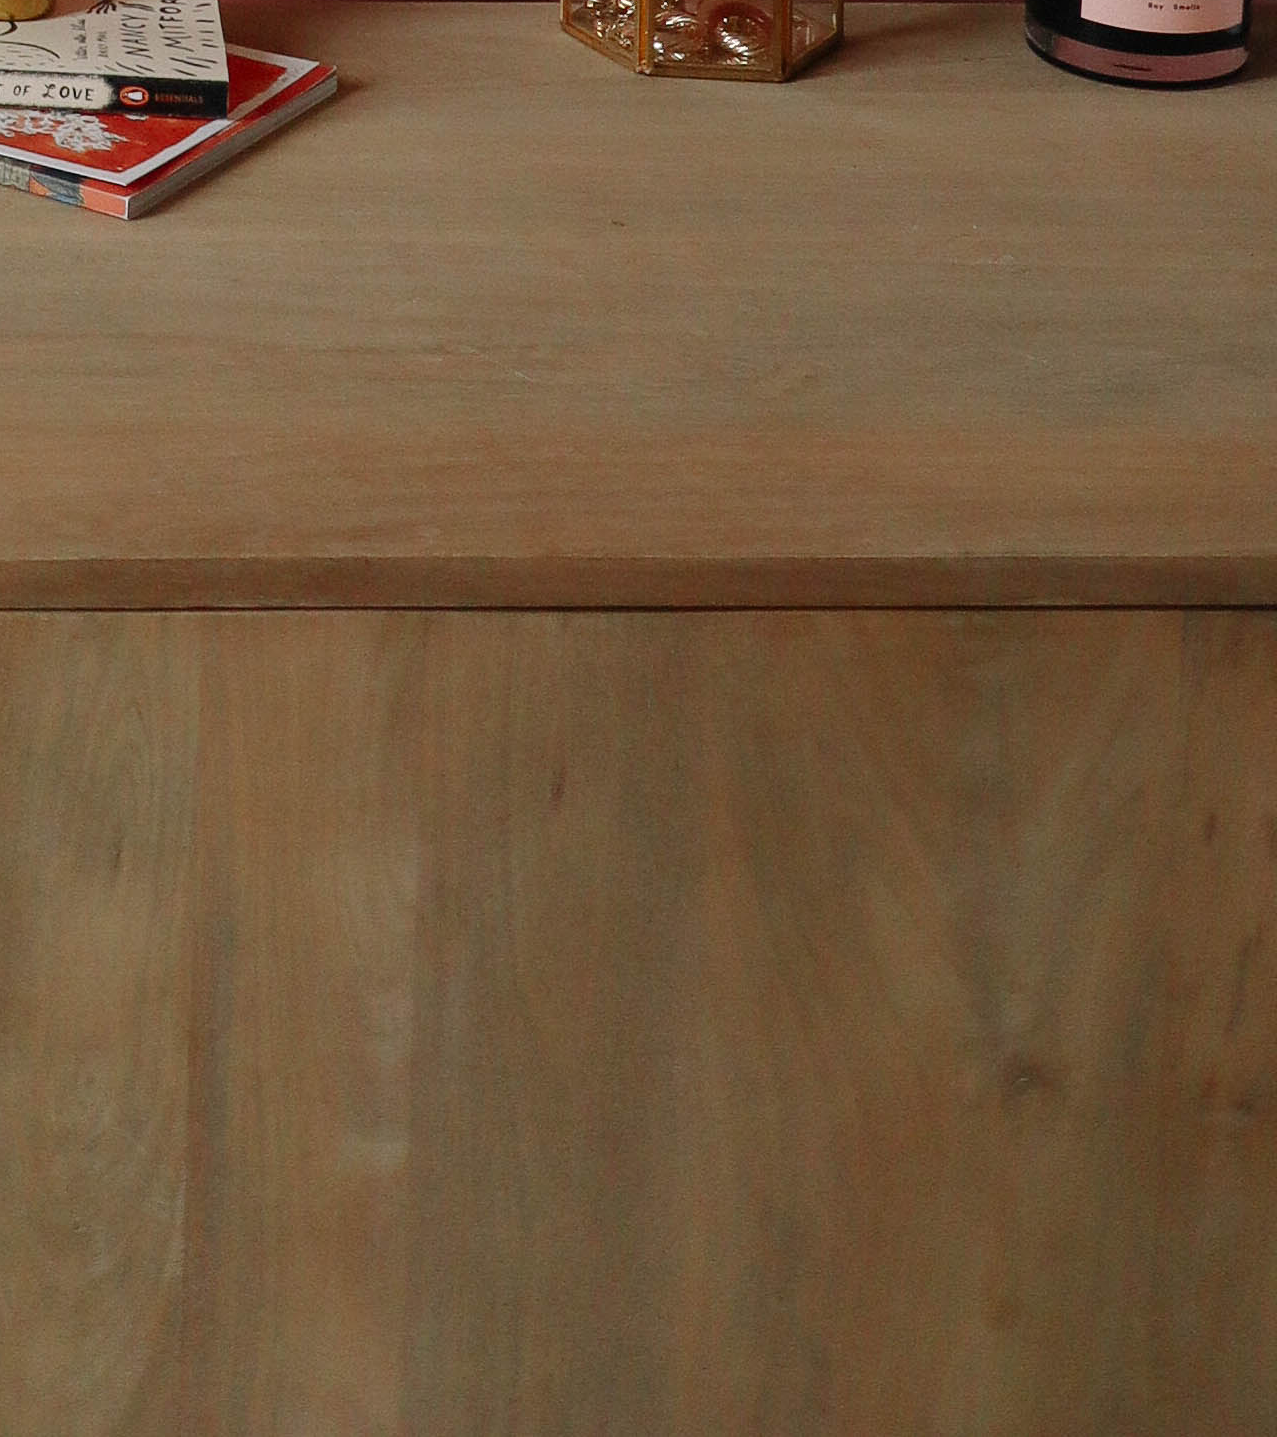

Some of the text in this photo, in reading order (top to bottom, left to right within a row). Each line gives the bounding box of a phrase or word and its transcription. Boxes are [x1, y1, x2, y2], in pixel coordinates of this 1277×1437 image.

[119, 13, 154, 59] NANCY
[13, 85, 31, 96] OF
[42, 83, 95, 102] LOVE
